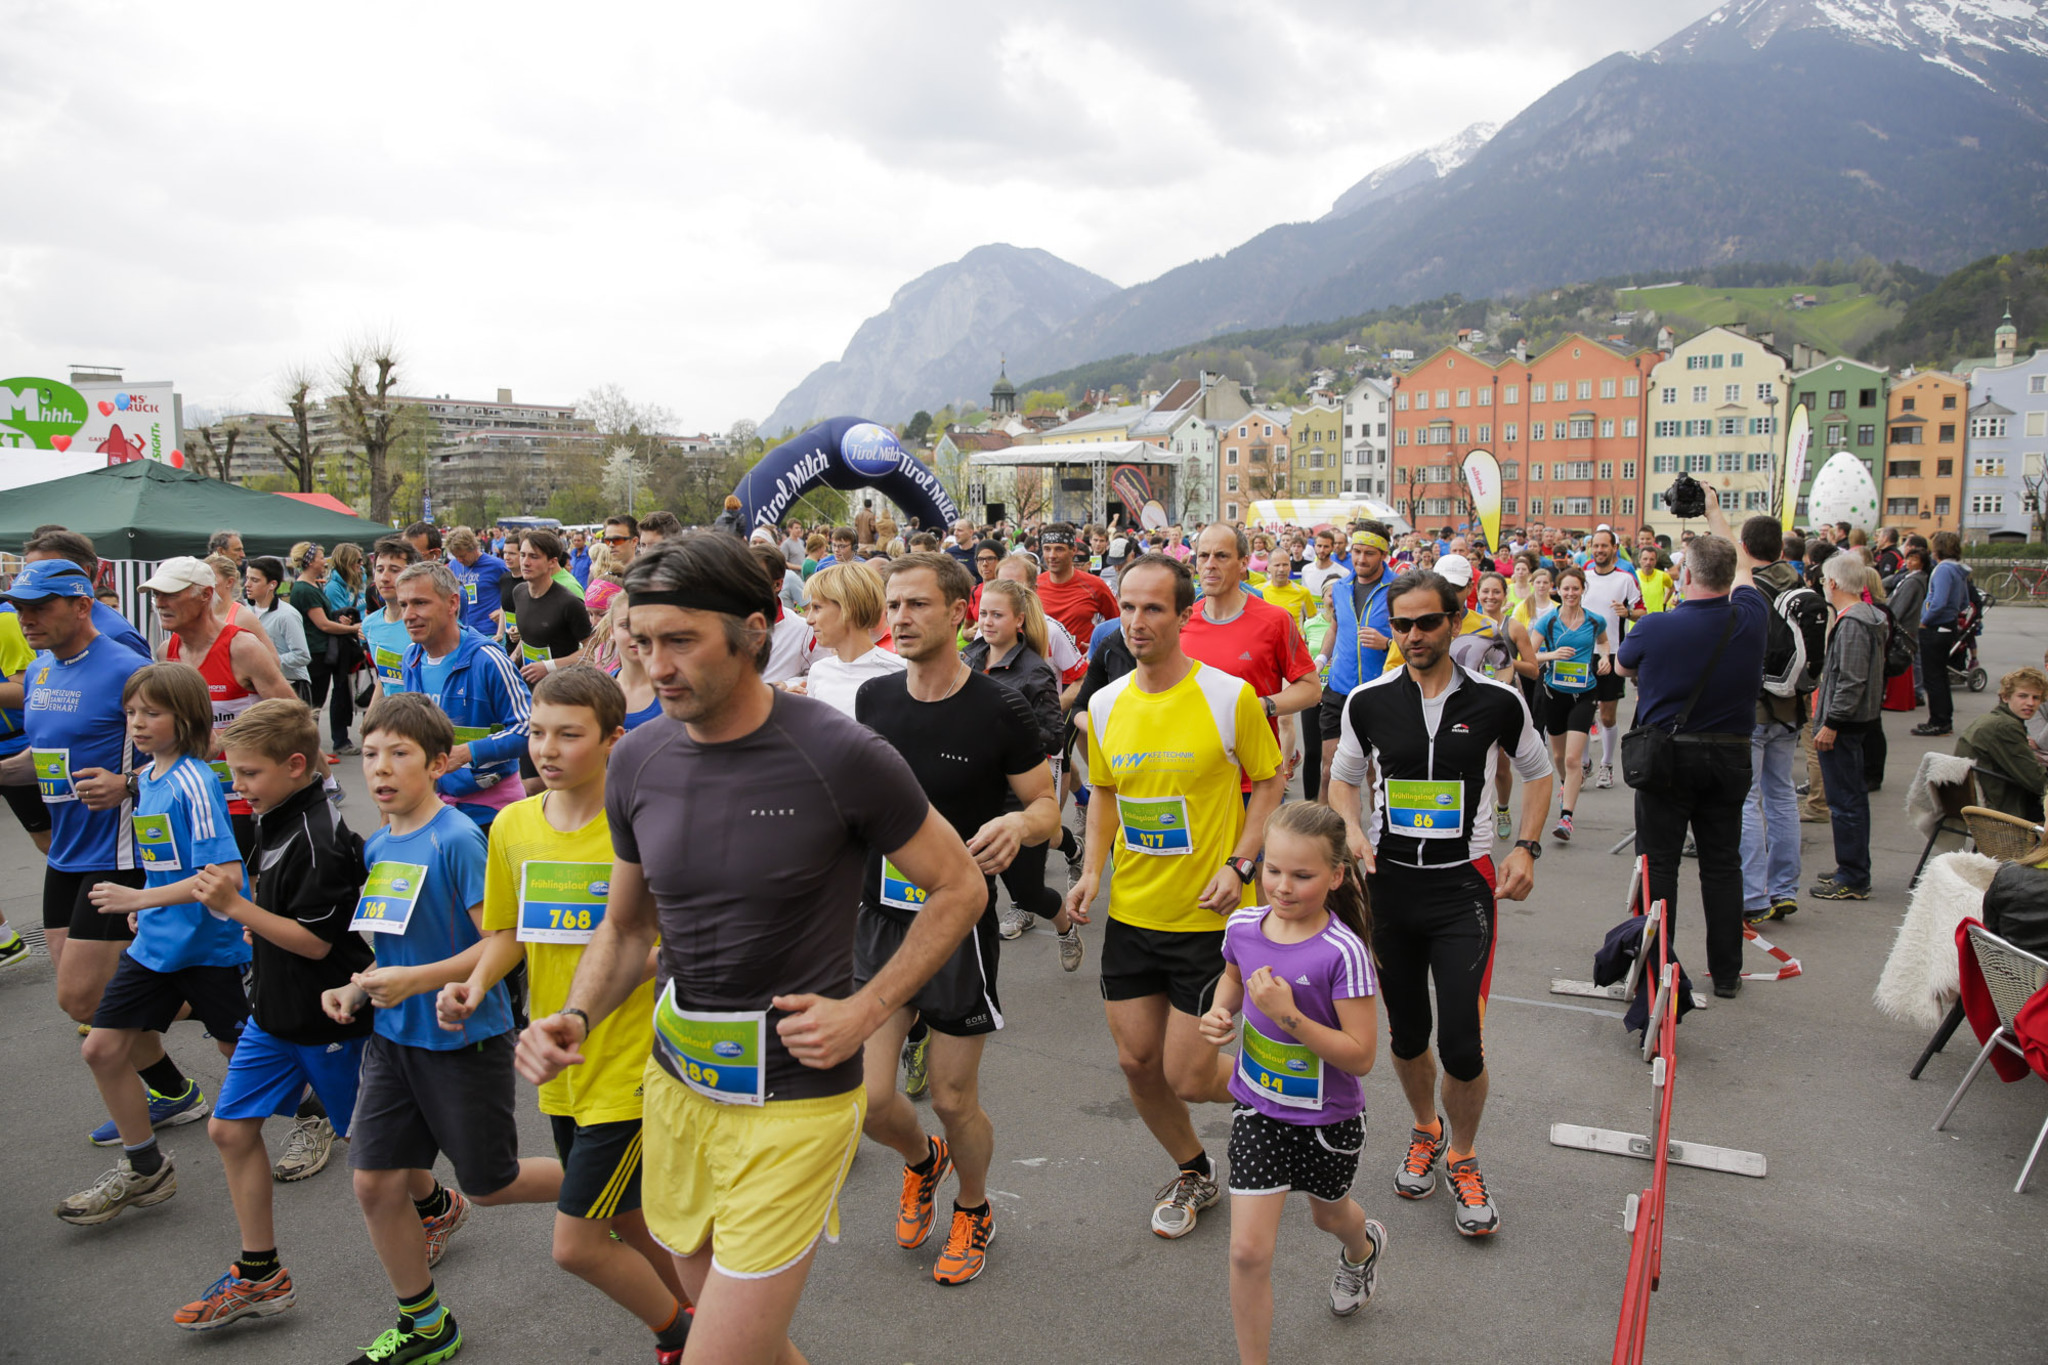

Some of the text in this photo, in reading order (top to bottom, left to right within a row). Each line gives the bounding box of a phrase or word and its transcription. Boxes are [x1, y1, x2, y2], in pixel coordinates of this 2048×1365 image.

[118, 404, 159, 413] RUCK
[851, 444, 900, 462] Tirol Milch
[899, 452, 934, 491] Tirol
[755, 448, 830, 526] Tirol Milch
[49, 703, 78, 712] ERHART
[1413, 813, 1434, 828] 86
[1139, 833, 1164, 847] 277
[530, 879, 589, 892] Frühlingslauf
[363, 901, 387, 918] 762
[549, 909, 592, 929] 768
[965, 1013, 987, 1025] GORE
[677, 1054, 720, 1088] 289
[1260, 1071, 1284, 1094] 84
